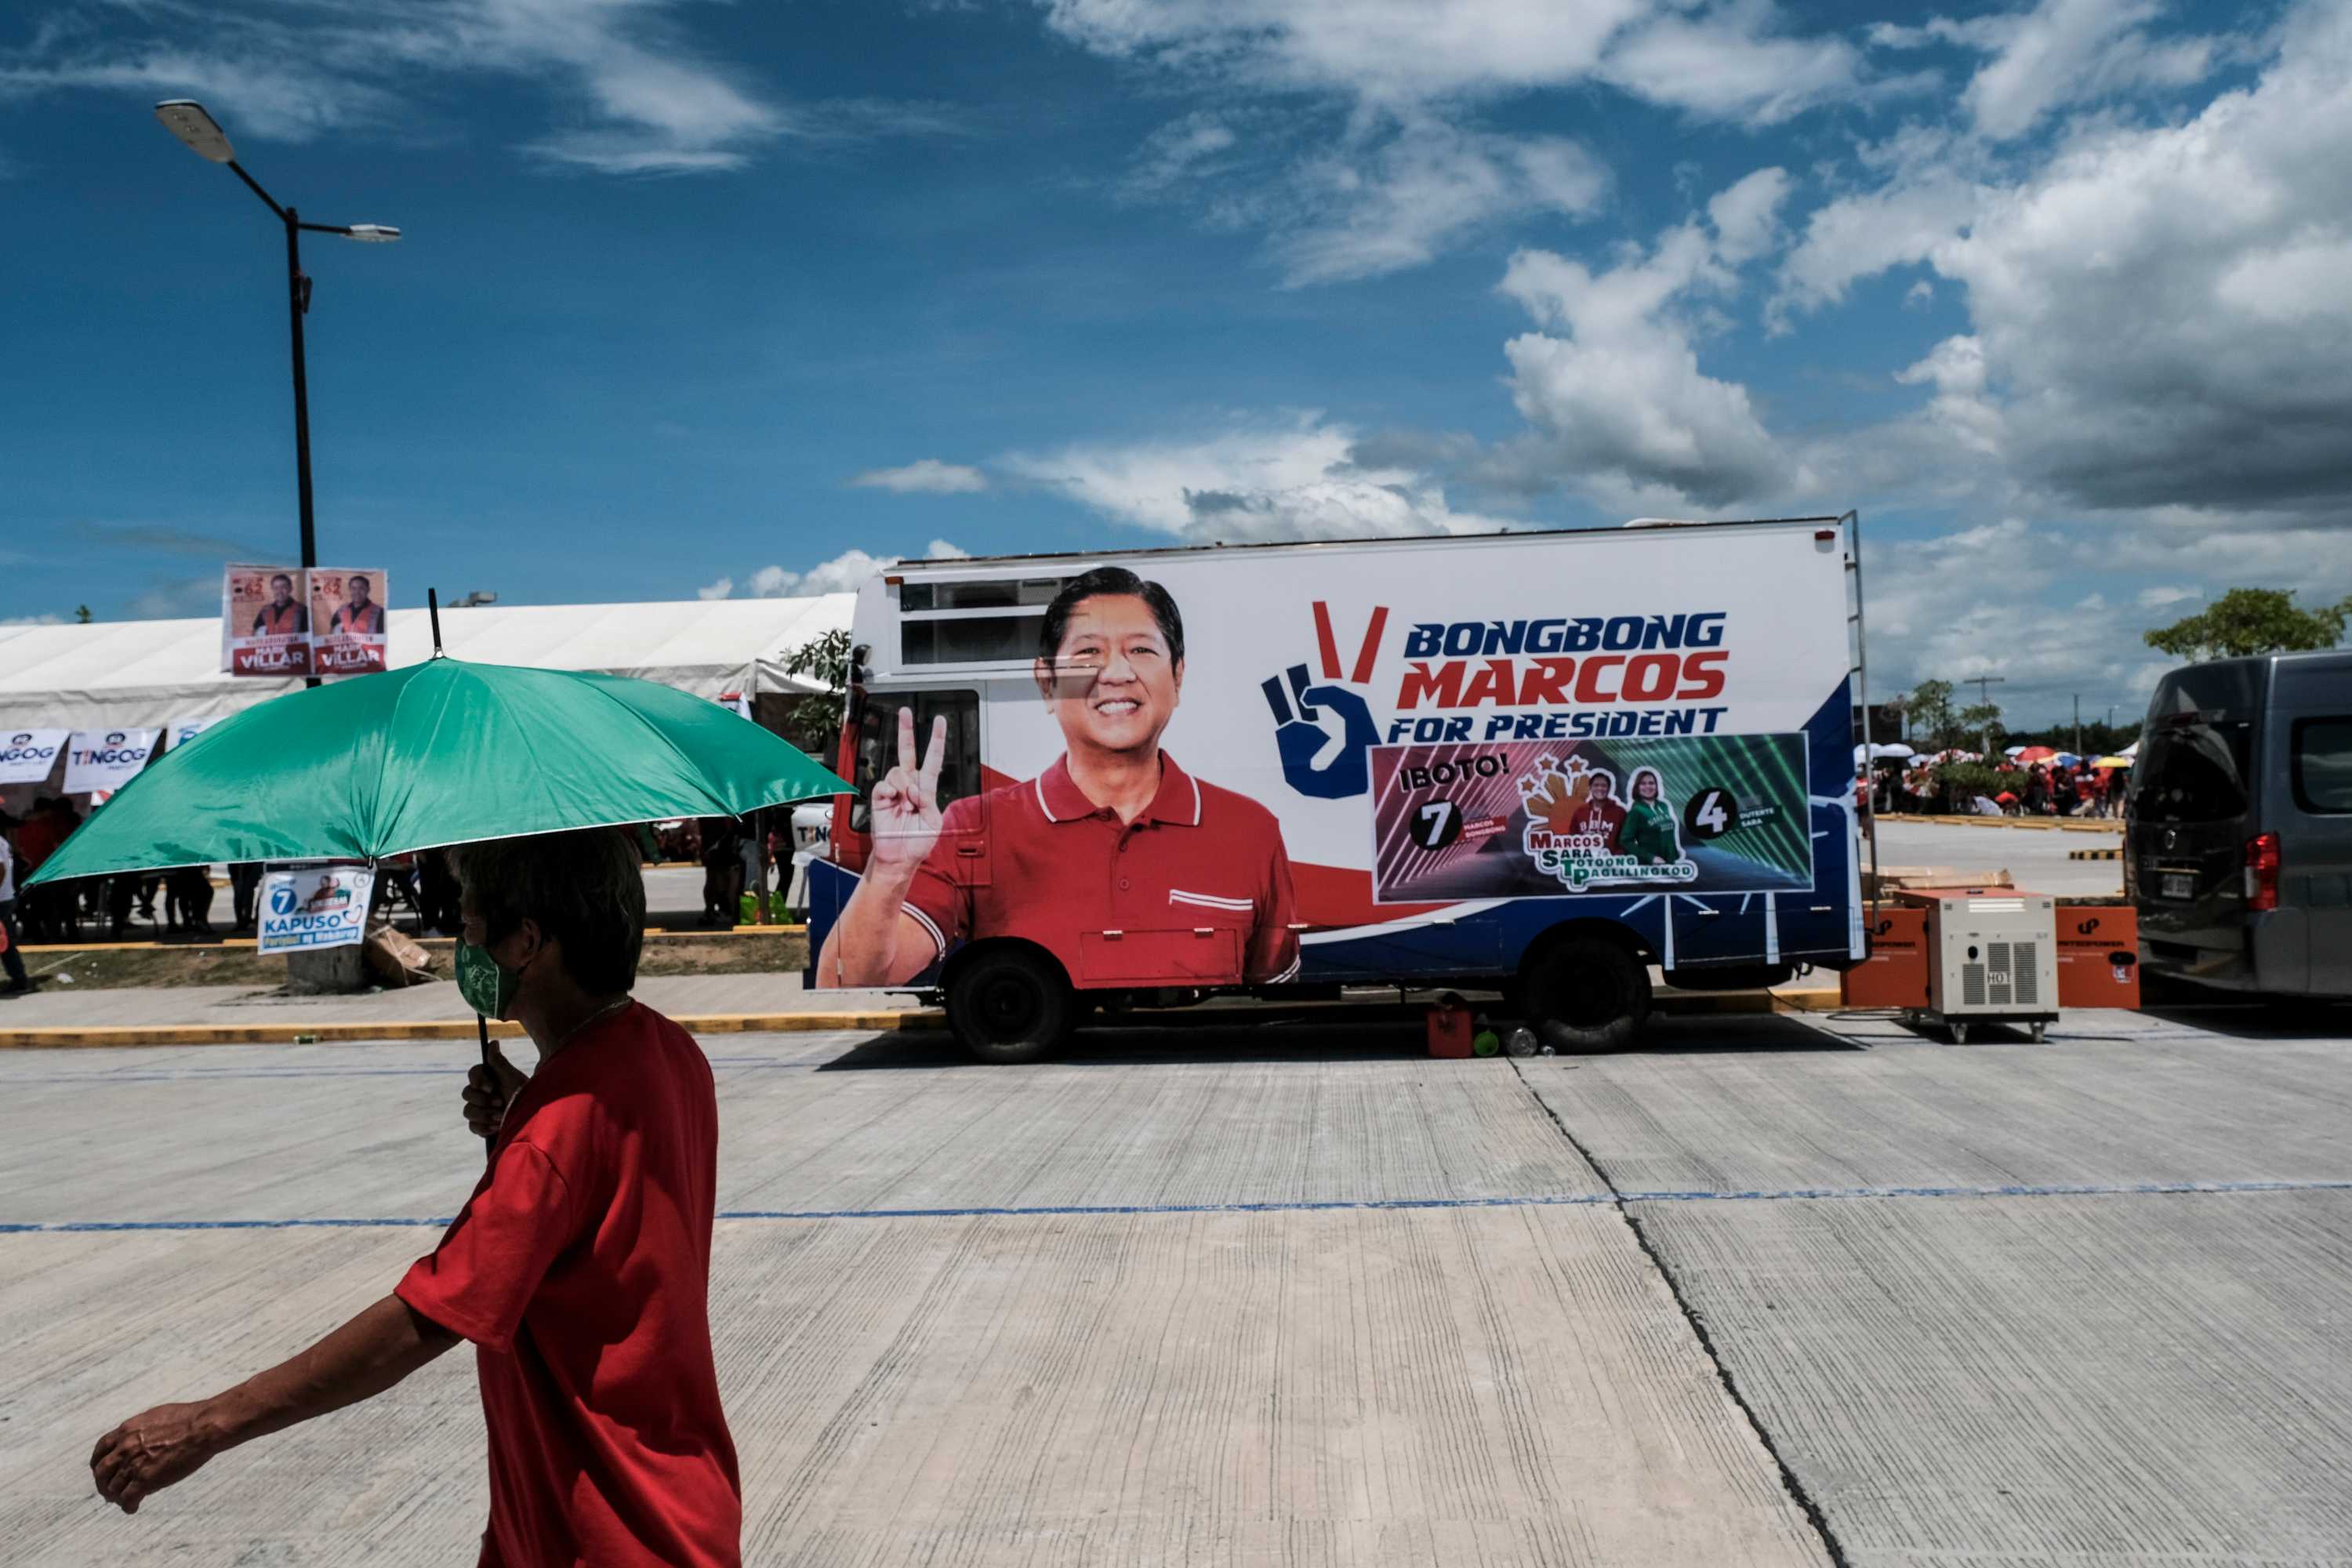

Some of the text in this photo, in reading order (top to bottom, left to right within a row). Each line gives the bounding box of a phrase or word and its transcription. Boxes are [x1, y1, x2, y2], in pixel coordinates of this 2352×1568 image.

[1403, 612, 1726, 658] BONGBONG
[239, 651, 304, 669] VILLAR
[321, 649, 380, 666] VILLAR
[1396, 651, 1730, 710] MARCOS
[1388, 707, 1729, 743] FOR PRESIDENT
[0, 746, 54, 763] NGOG
[1399, 753, 1510, 792] IBOTO!
[1696, 791, 1727, 833] 4
[1740, 808, 1774, 819] DUTERTE
[1421, 801, 1452, 846] 7
[1464, 820, 1494, 830] MARCOS
[1741, 818, 1762, 827] SARA
[797, 826, 831, 843] TIN
[1465, 826, 1506, 838] BONGBONG
[1530, 833, 1602, 849] MARCOS
[1542, 849, 1592, 867] SARA
[1560, 857, 1635, 877] TOTOONG
[1573, 867, 1693, 885] PAGLILINGKOD
[275, 891, 292, 913] 7
[264, 916, 340, 933] KAPUSO
[1987, 971, 2010, 985] HOT
